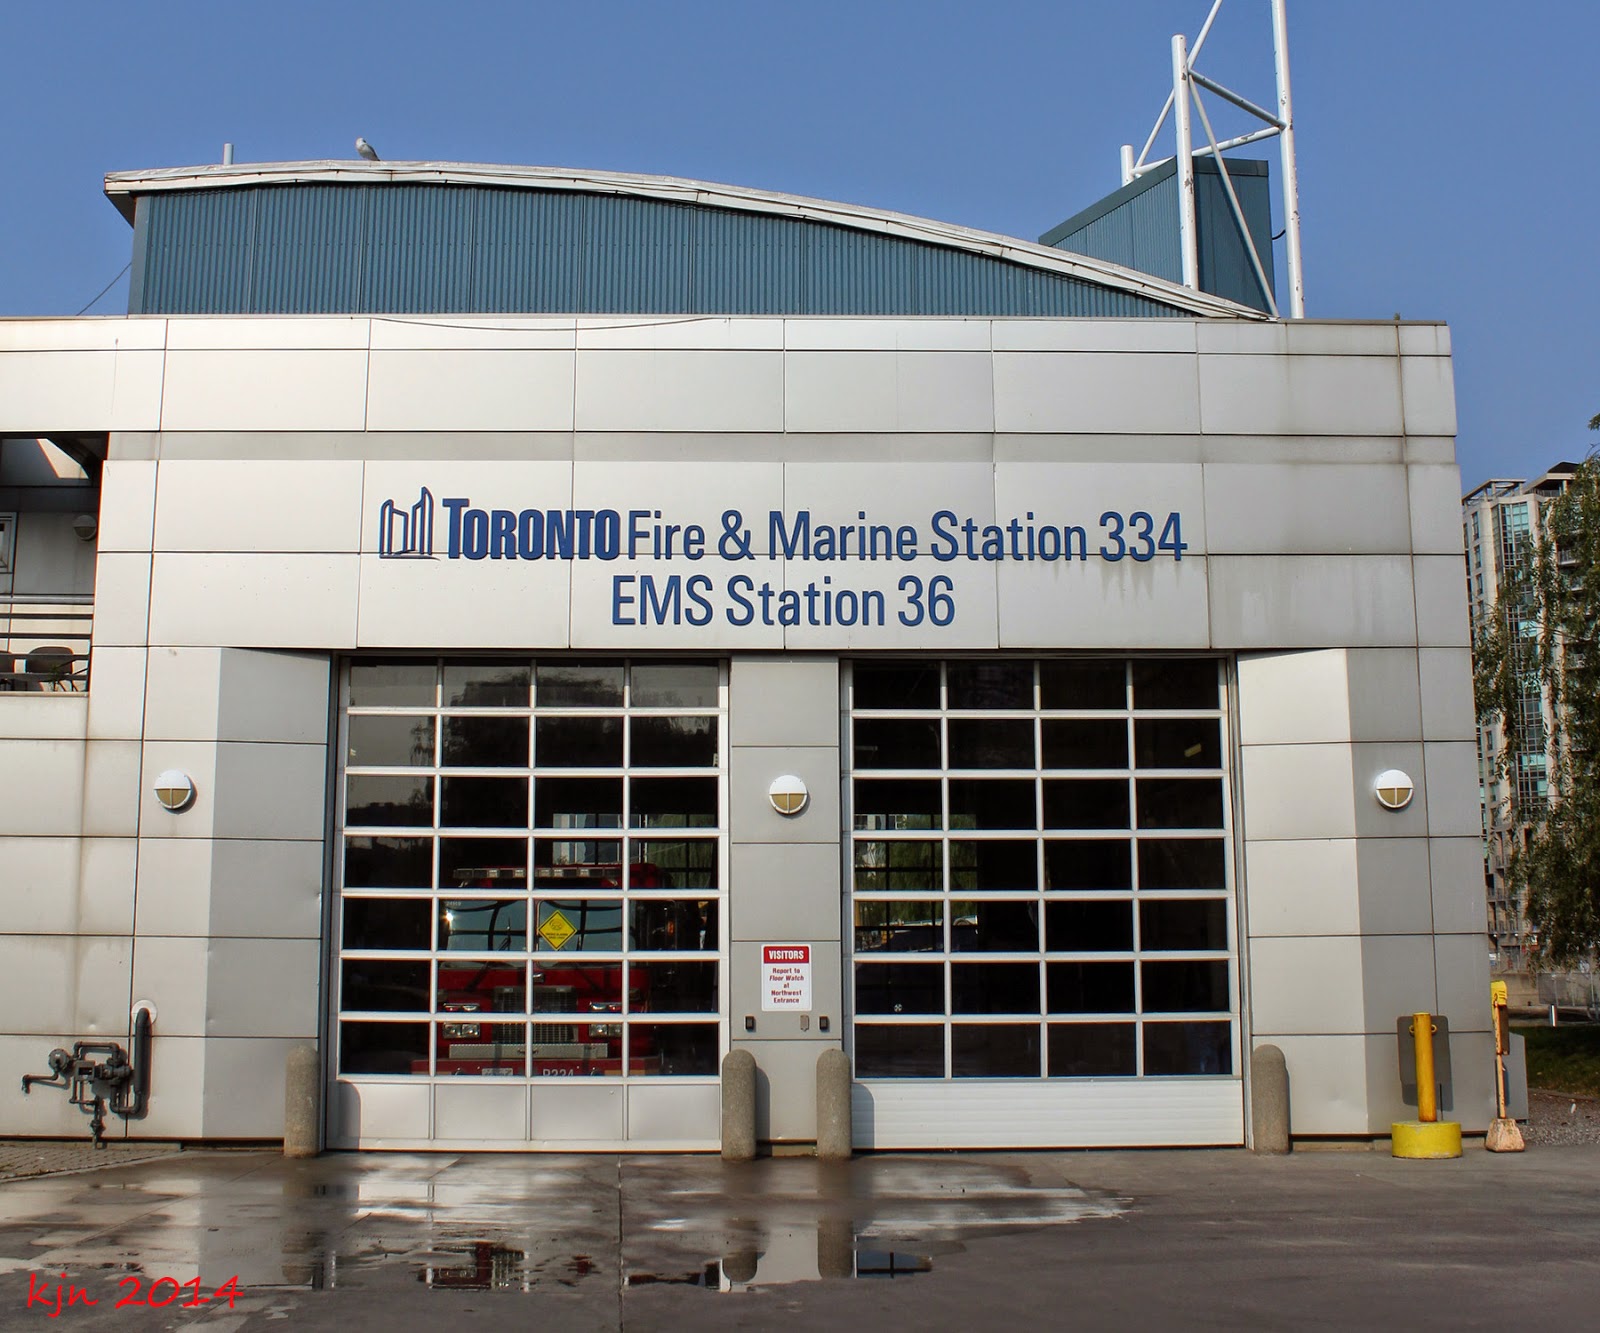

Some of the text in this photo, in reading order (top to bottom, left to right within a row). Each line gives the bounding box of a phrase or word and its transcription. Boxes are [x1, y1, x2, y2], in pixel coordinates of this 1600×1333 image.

[442, 498, 1188, 561] TORONTO Fire & Marine Station 334
[612, 575, 955, 626] EMS Station 36
[768, 950, 804, 960] VISITORS
[772, 967, 792, 975] Report
